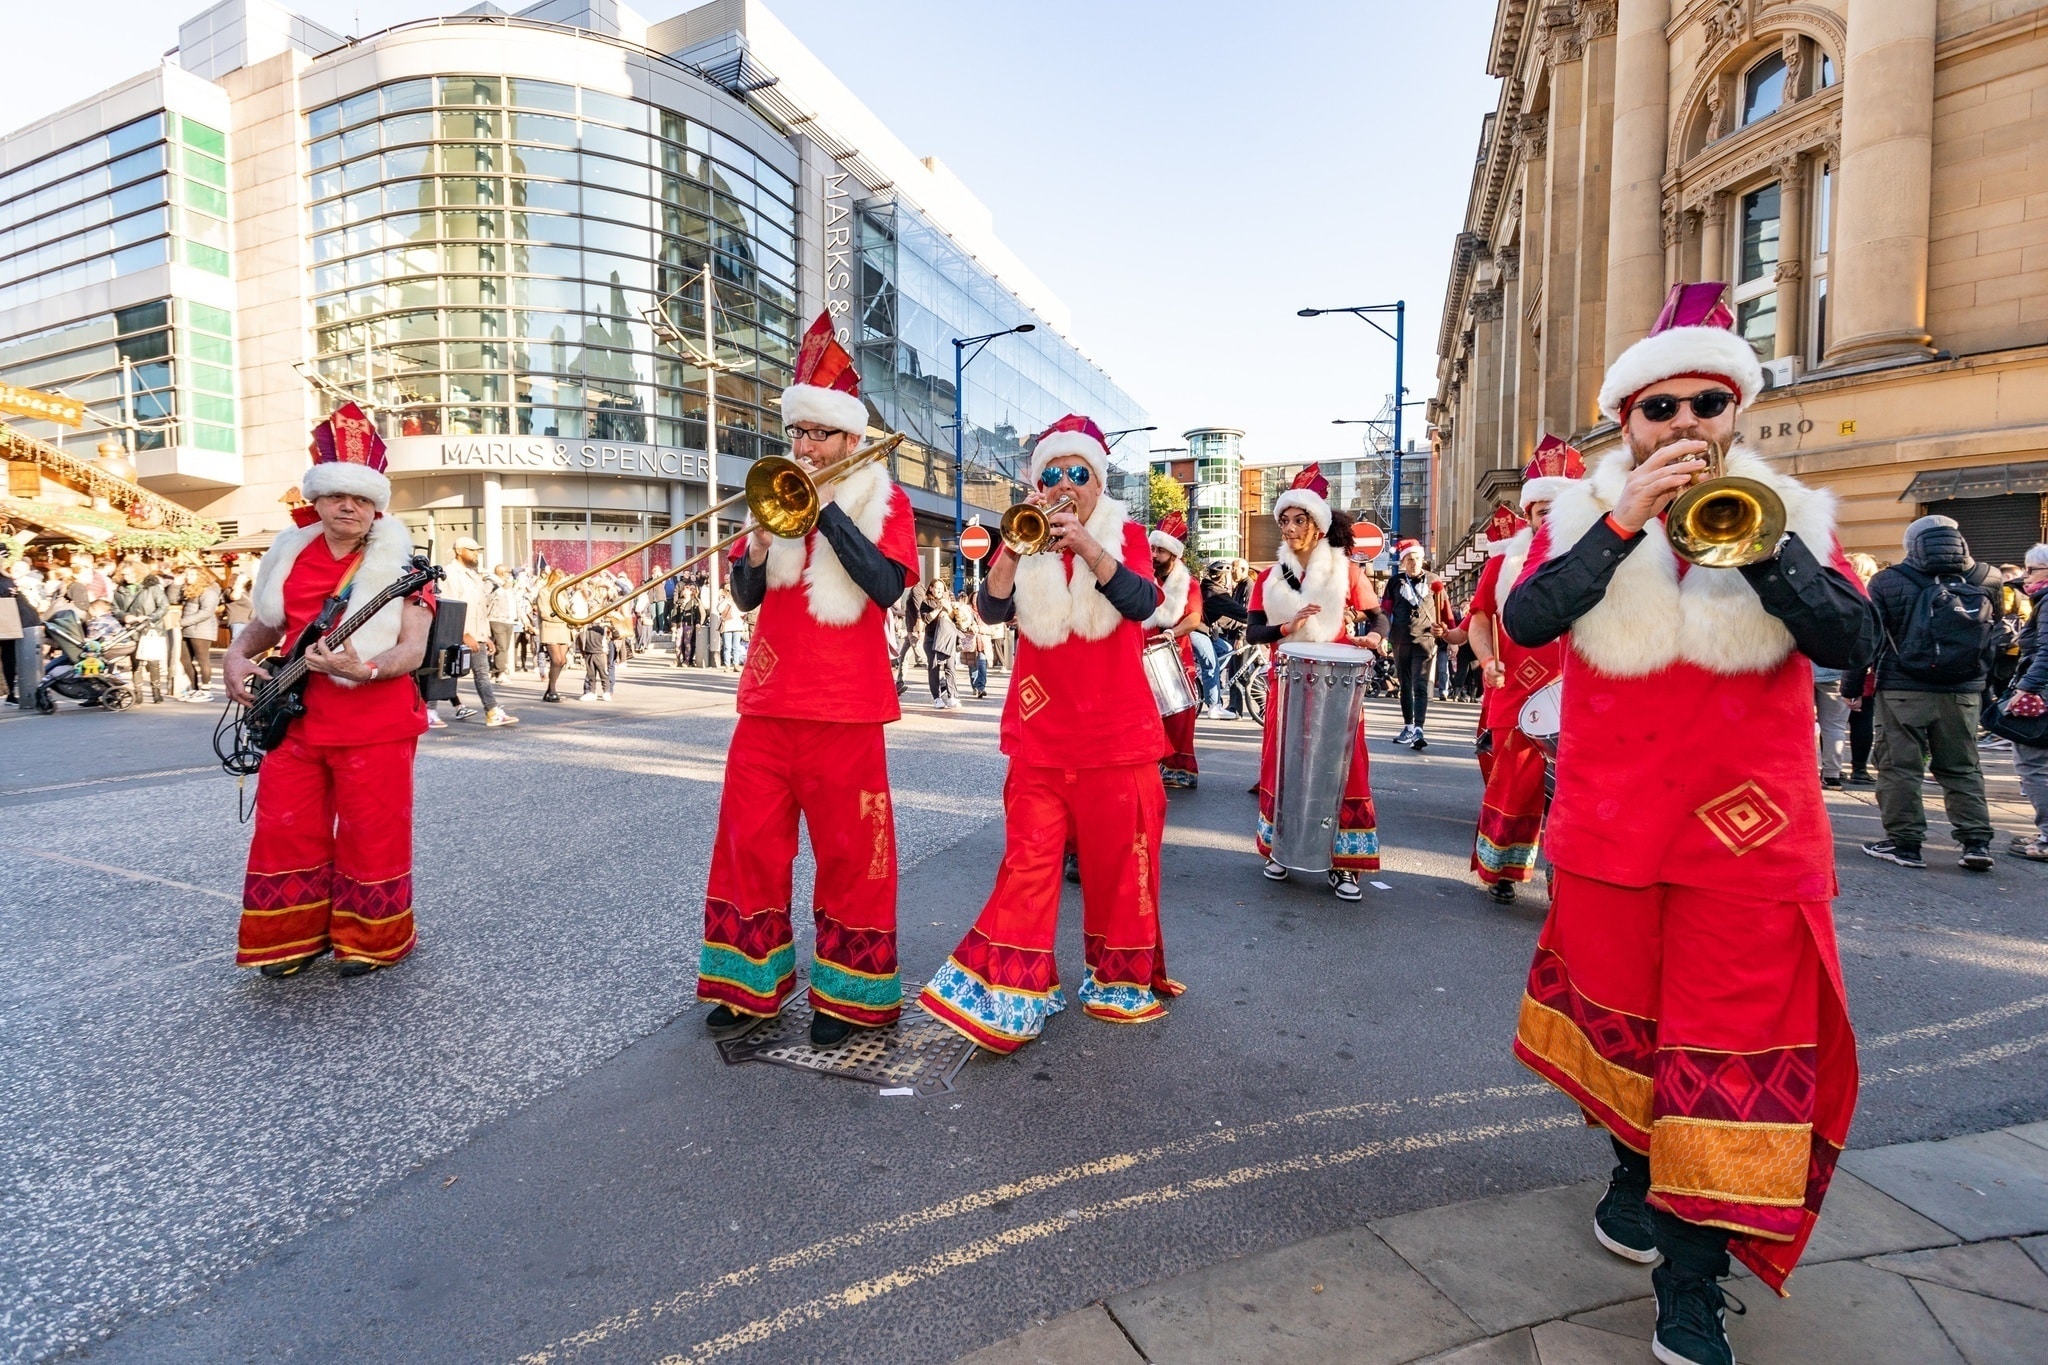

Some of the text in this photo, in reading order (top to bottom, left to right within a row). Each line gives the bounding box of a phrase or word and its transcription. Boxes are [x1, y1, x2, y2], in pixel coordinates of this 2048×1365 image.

[826, 172, 850, 291] MARKS
[828, 299, 850, 318] &
[1760, 419, 1813, 440] BRO
[441, 443, 710, 478] MARKS & SPENCER
